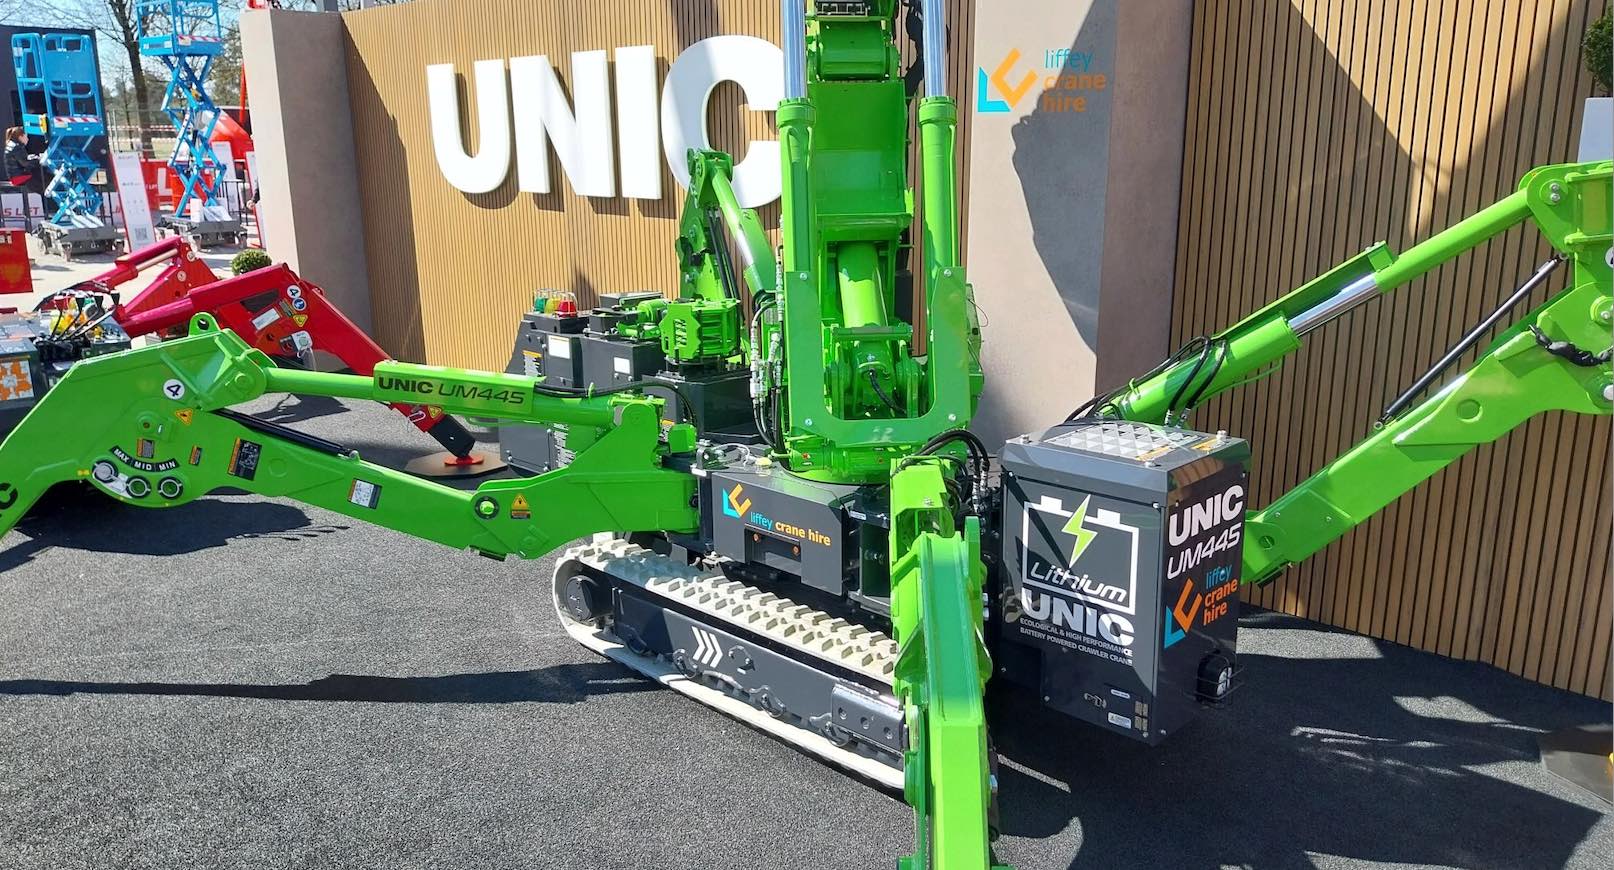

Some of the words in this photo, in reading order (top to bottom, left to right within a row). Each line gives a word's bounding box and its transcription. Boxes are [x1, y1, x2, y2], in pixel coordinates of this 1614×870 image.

[1045, 48, 1093, 72] liffey
[1043, 72, 1107, 91] crane
[1043, 94, 1087, 112] hire
[427, 35, 783, 208] UNIC
[15, 207, 40, 216] LFT
[167, 383, 181, 397] 4
[378, 376, 434, 396] UNIC
[438, 383, 527, 406] UM445
[114, 448, 130, 463] MAX
[134, 461, 152, 471] MID
[159, 461, 176, 471] MIN
[750, 511, 773, 531] liffey
[775, 521, 806, 539] crane
[808, 527, 832, 546] hire
[1168, 484, 1244, 547] UNIC
[1167, 523, 1241, 580] UM445
[1030, 560, 1128, 604] Lithium
[1205, 563, 1232, 590] liffey
[1204, 578, 1238, 607] crane
[1021, 586, 1135, 646] UNIC
[1202, 603, 1228, 627] hire
[1020, 618, 1059, 634] ECOLOGICAL
[1059, 629, 1065, 637] &
[1066, 632, 1082, 641] HIGH
[1082, 636, 1133, 657] PERFORMANCE
[1020, 627, 1046, 640] BATTERY
[1046, 635, 1077, 650] POWERED
[1078, 645, 1108, 659] CRAWLER
[1109, 654, 1133, 666] CRANE
